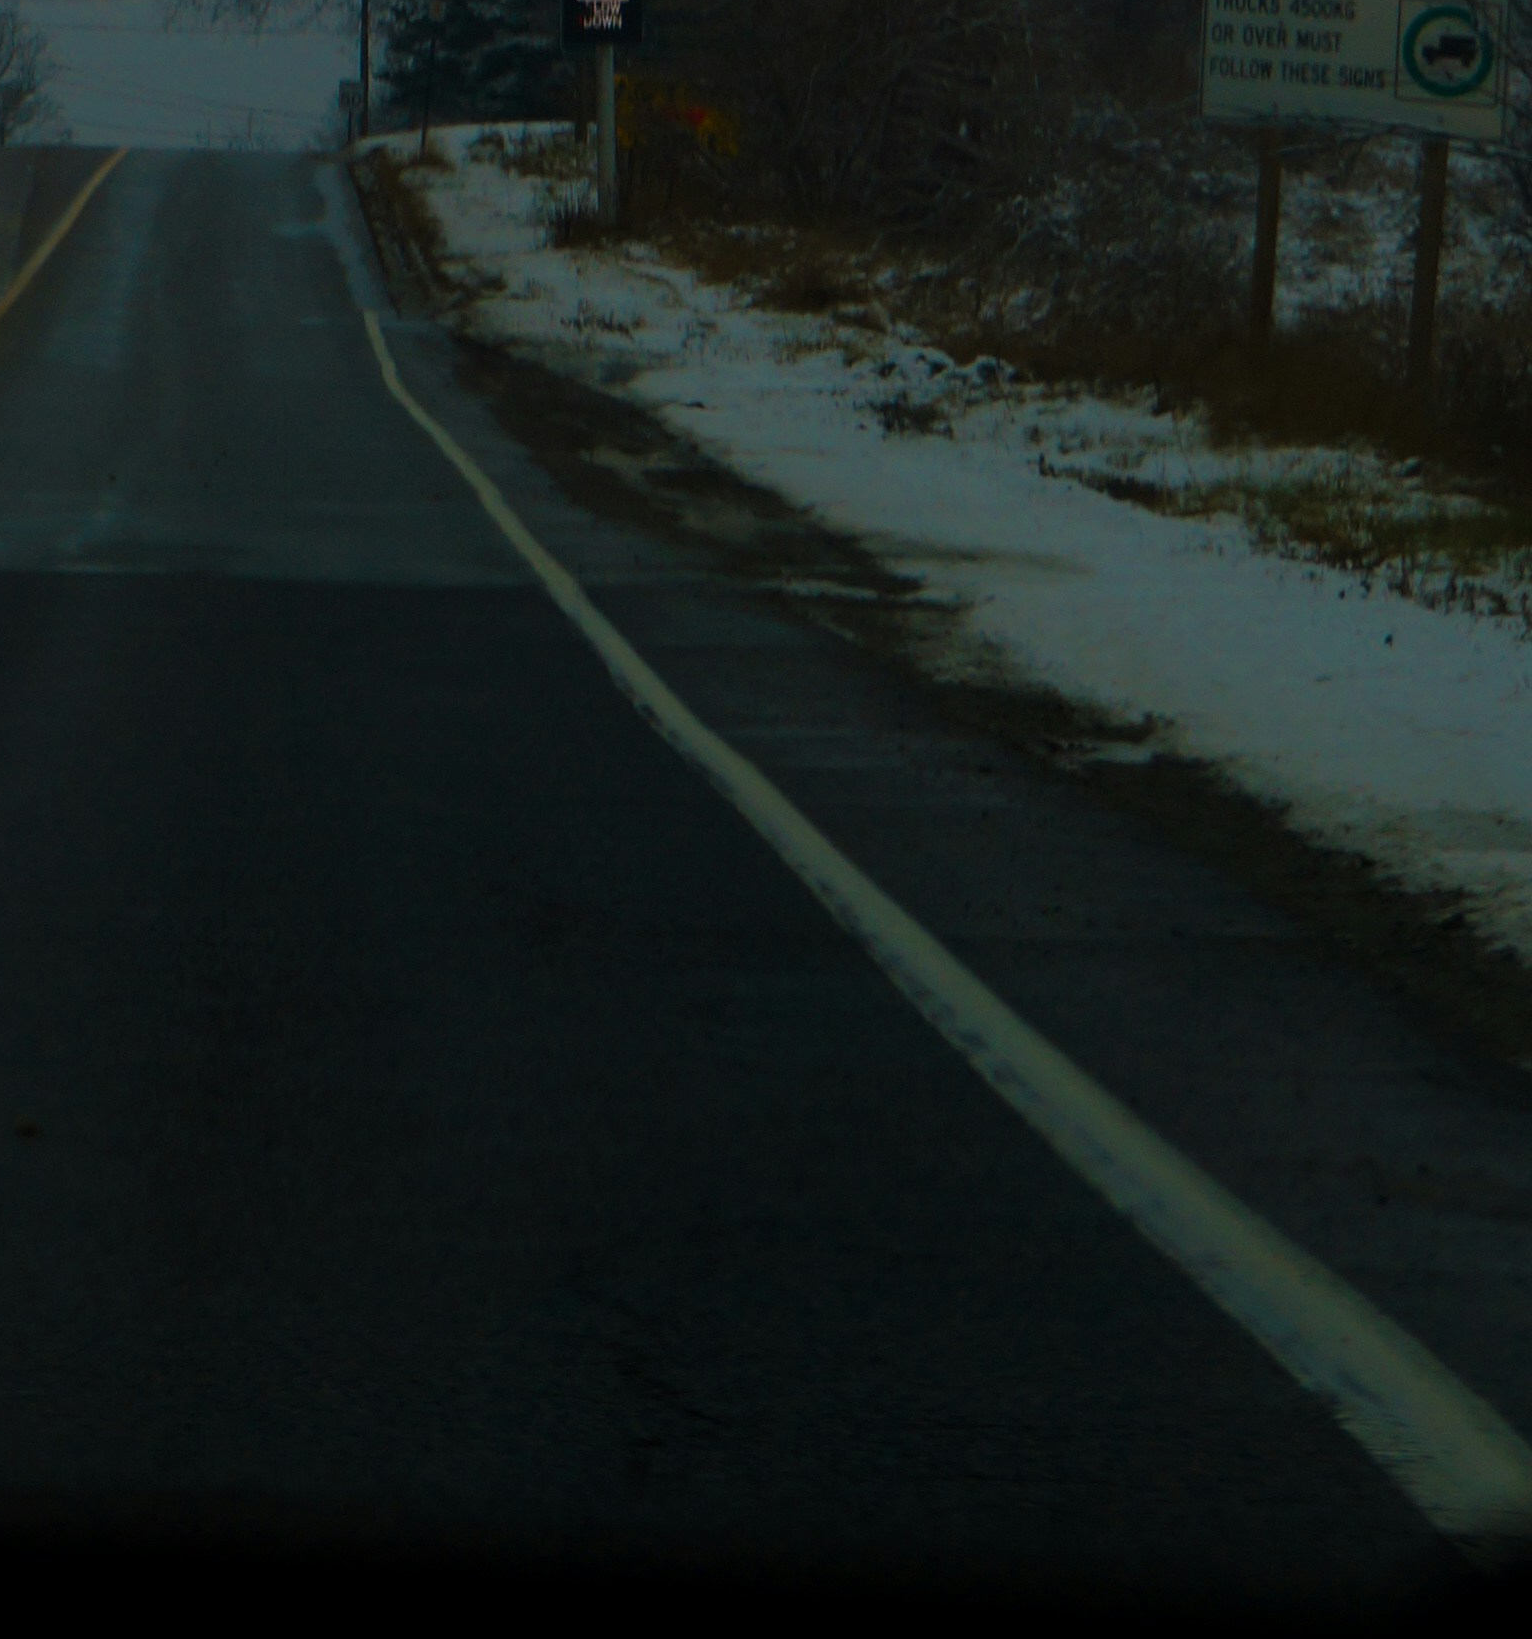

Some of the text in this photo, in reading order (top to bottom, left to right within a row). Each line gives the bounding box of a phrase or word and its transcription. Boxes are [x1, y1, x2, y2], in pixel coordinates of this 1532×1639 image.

[1212, 22, 1343, 52] OR OVER MUST
[1209, 55, 1386, 89] FOLLOW THESE SIGNS
